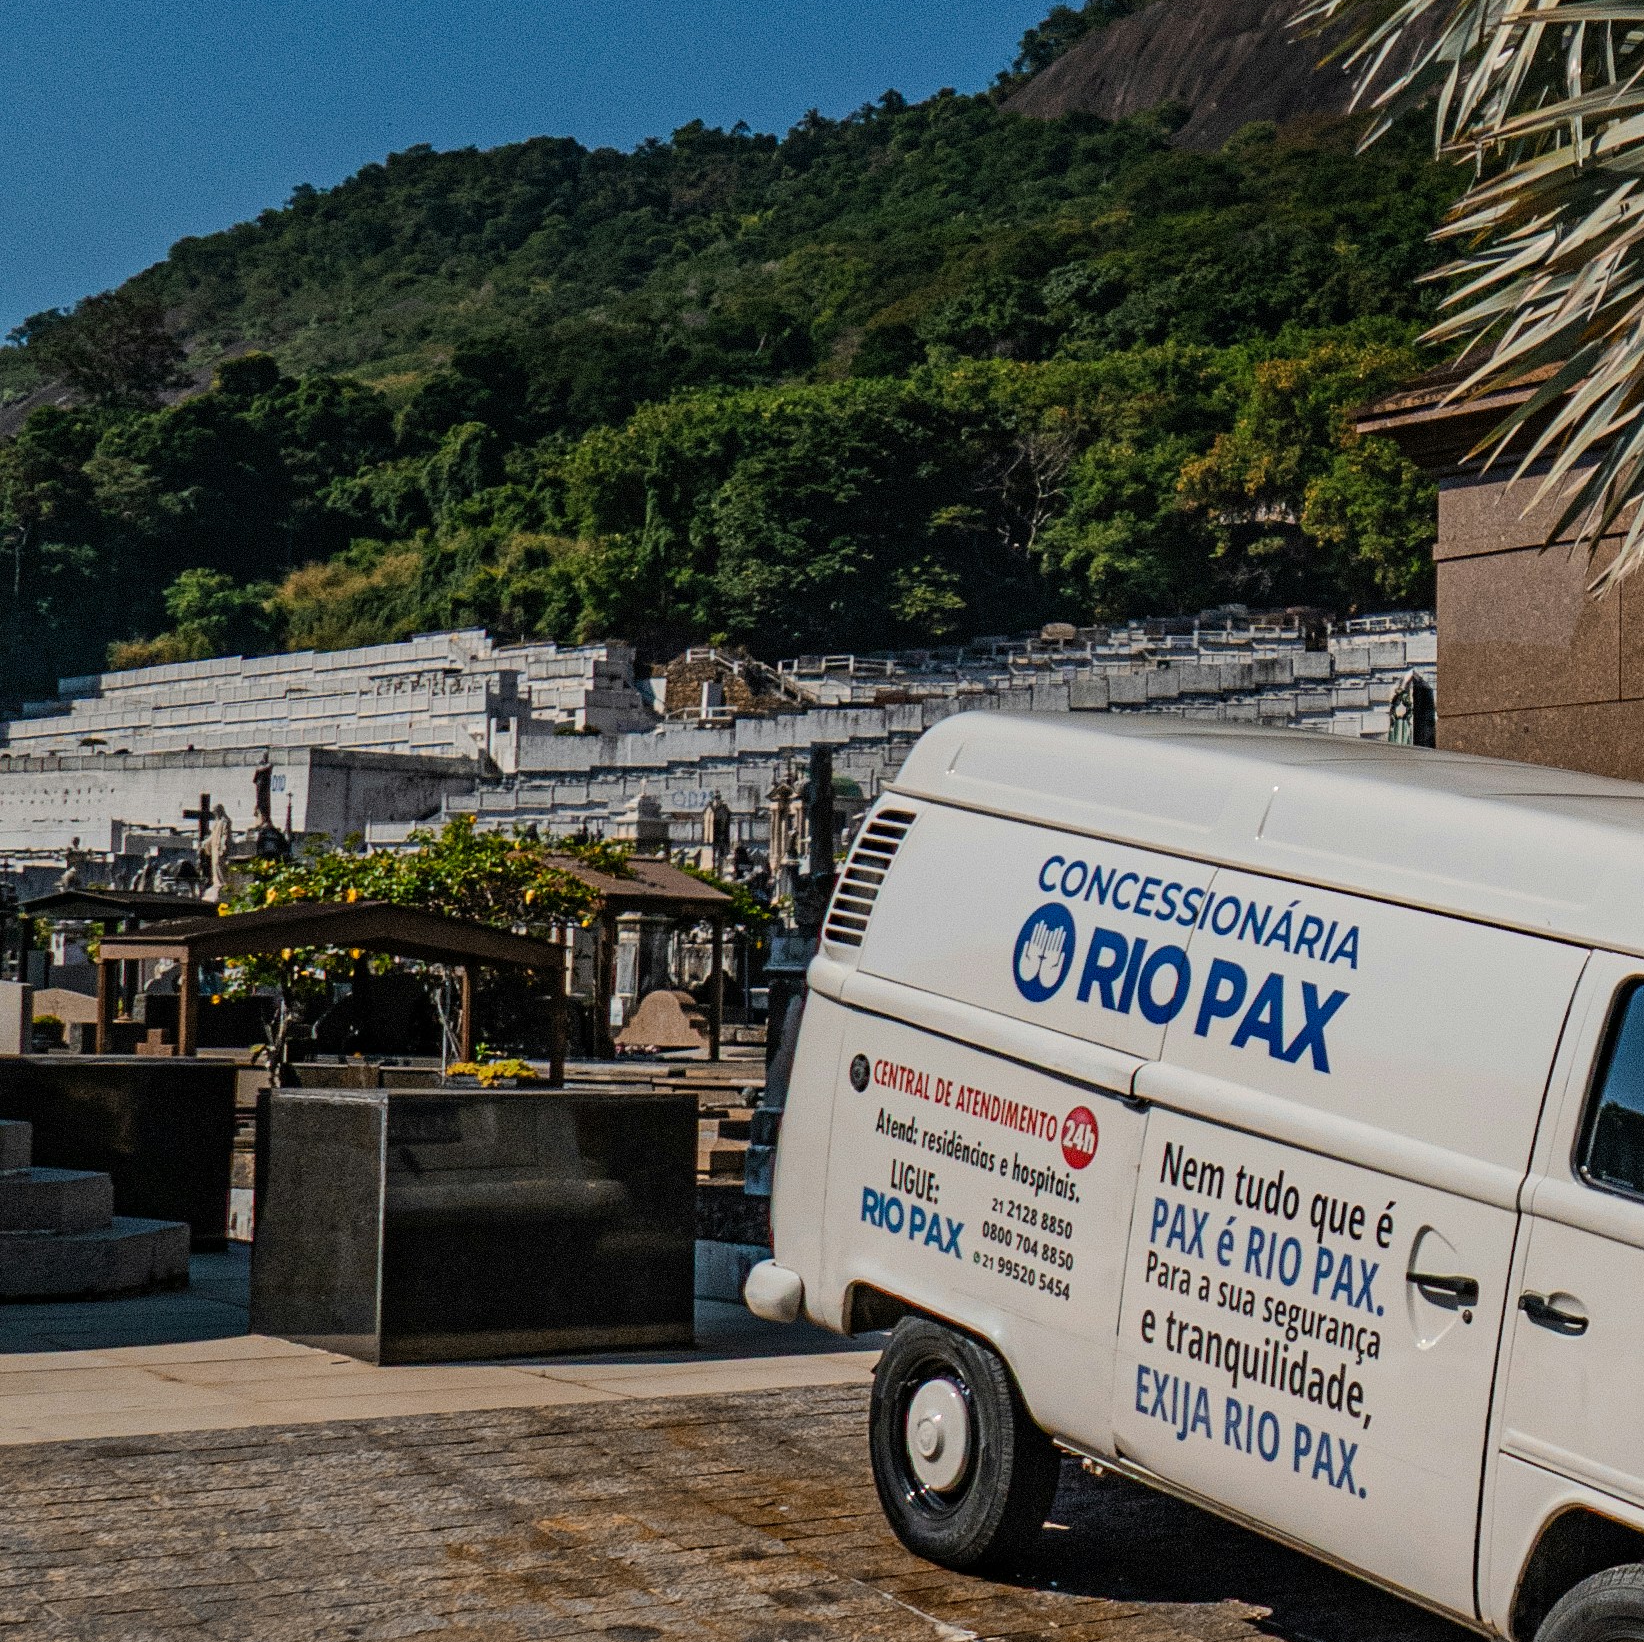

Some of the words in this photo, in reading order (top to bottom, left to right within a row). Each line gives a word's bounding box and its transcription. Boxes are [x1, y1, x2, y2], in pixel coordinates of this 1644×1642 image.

[1038, 855, 1360, 970] CONCESSIONÁRIA
[1076, 926, 1192, 1025] RIO
[1194, 957, 1351, 1074] PAX
[873, 1059, 931, 1100] CENTRAL
[934, 1077, 954, 1107] DE
[955, 1085, 1058, 1142] ATENDIMENTO
[1062, 1119, 1096, 1155] 24h
[875, 1107, 918, 1145] Atend:
[921, 1127, 995, 1173] residências
[999, 1156, 1008, 1177] e
[1011, 1153, 1080, 1203] hospitais.
[861, 1186, 904, 1234] RIO
[908, 1204, 965, 1260] PAX
[890, 1158, 940, 1204] LIGUE:
[991, 1198, 1004, 1214] 21
[1006, 1200, 1038, 1227] 2128
[1040, 1212, 1073, 1239] 8850
[1160, 1141, 1226, 1199] Nem
[1235, 1164, 1301, 1221] tudo
[1309, 1193, 1367, 1245] que
[1376, 1200, 1397, 1249] é
[982, 1220, 1012, 1247] 0800
[1016, 1233, 1038, 1258] 704
[1041, 1242, 1074, 1271] 8850
[982, 1253, 994, 1270] 21
[997, 1256, 1036, 1287] 99520
[1038, 1271, 1071, 1301] 5454
[1150, 1196, 1210, 1259] PAX
[1216, 1215, 1238, 1267] é
[1244, 1225, 1302, 1287] RIO
[1312, 1246, 1385, 1317] PAX.
[1145, 1249, 1191, 1297] Para
[1198, 1275, 1211, 1302] a
[1217, 1280, 1256, 1317] sua
[1262, 1295, 1382, 1366] segurança
[1141, 1309, 1156, 1344] e
[1165, 1310, 1373, 1431] tranquilidade,
[1135, 1364, 1213, 1441] EXIJA
[1224, 1395, 1281, 1463] RIO
[1293, 1421, 1368, 1500] PAX.
